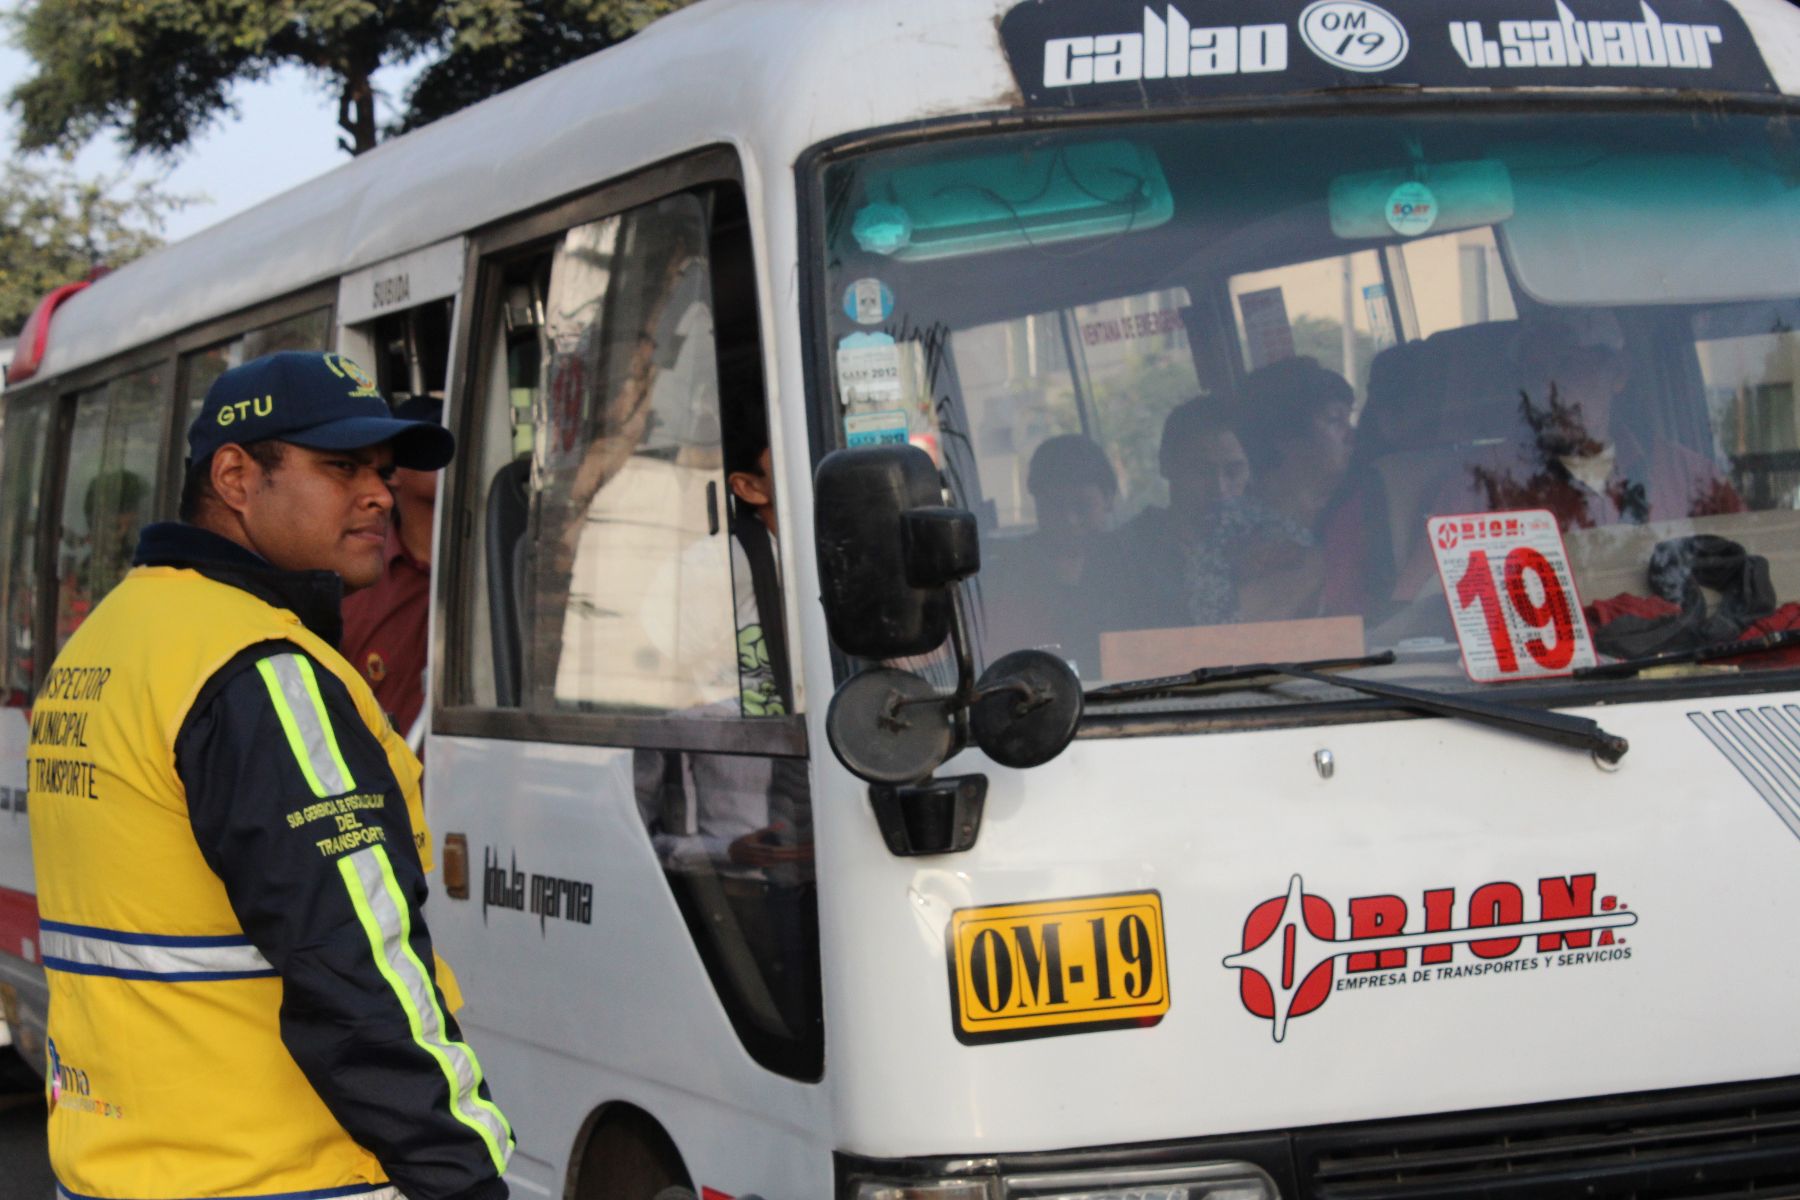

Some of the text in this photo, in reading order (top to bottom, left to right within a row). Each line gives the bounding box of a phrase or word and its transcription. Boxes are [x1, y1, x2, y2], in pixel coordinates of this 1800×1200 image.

[1321, 11, 1366, 31] OM
[1335, 32, 1384, 56] 19
[871, 366, 897, 379] 2012
[217, 395, 273, 426] GTU
[1456, 547, 1575, 673] 19
[31, 712, 88, 747] MUNICIPAL
[36, 758, 98, 800] TRANSPORTE
[335, 812, 363, 832] DEL
[970, 914, 1153, 1013] OM-19
[1336, 973, 1407, 992] EMPRESA
[1412, 970, 1432, 983] DE
[1436, 958, 1539, 980] TRANSPORTES
[1558, 948, 1633, 967] SERVICIOS
